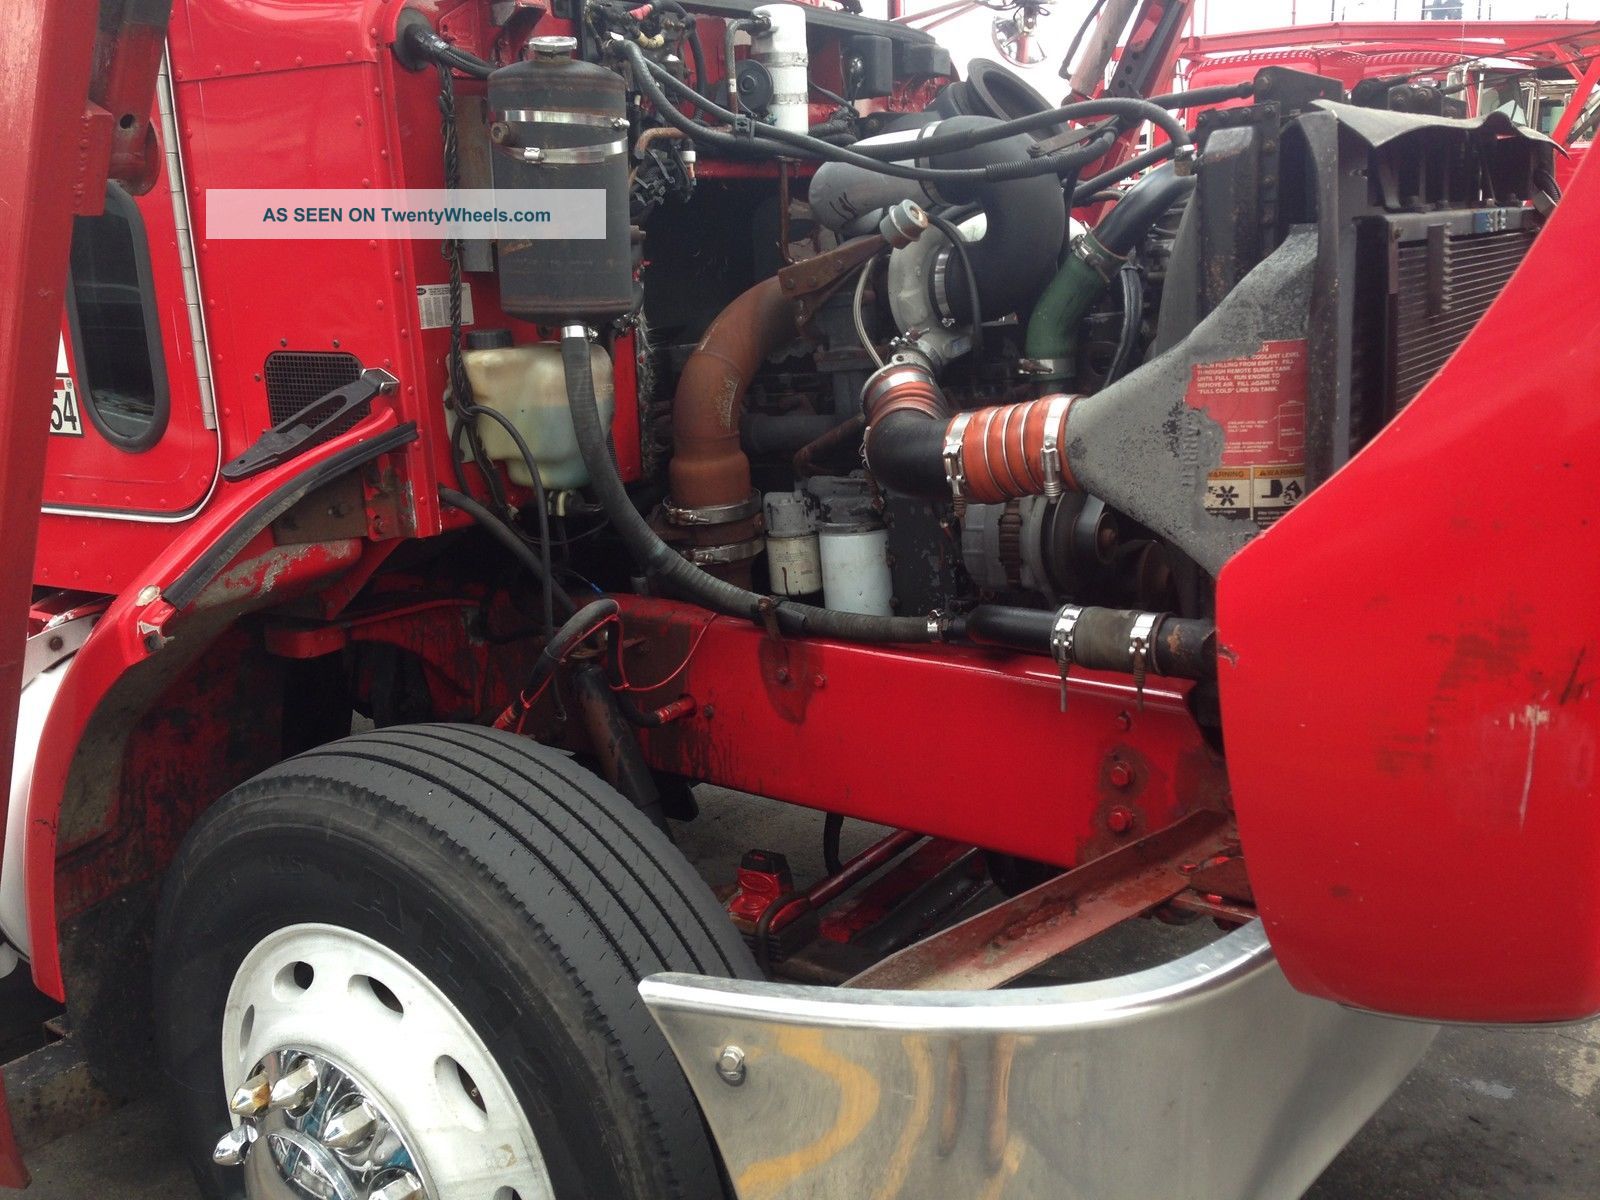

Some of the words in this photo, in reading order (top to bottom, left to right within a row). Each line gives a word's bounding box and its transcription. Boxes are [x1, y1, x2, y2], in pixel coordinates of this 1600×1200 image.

[1215, 361, 1238, 369] FILLING
[1239, 360, 1257, 368] FROM
[1197, 368, 1226, 376] THROUGH
[1226, 367, 1252, 375] REMOTE
[1252, 366, 1274, 374] SURGE
[1274, 364, 1291, 372] TANK
[1234, 373, 1248, 381] RUN
[1250, 379, 1271, 387] AGAIN
[1235, 386, 1250, 394] LINE
